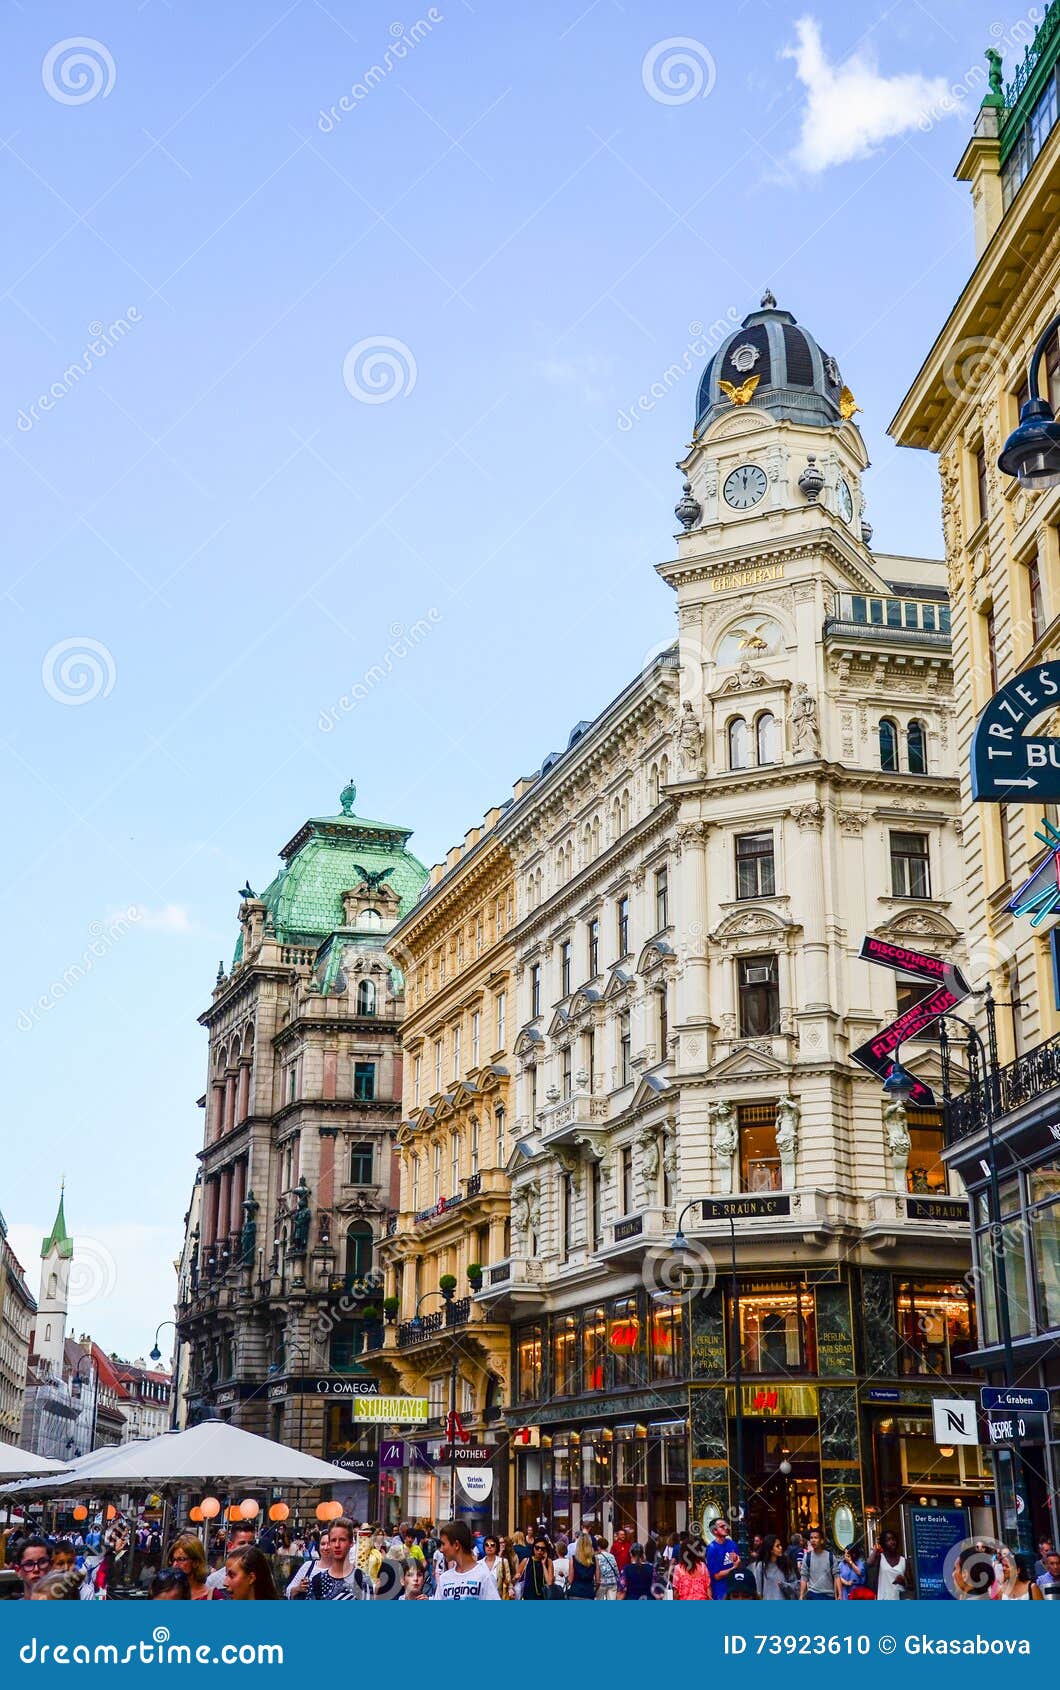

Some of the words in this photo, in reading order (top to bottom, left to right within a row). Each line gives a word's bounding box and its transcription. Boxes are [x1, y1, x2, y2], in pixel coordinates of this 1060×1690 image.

[711, 564, 785, 592] GENERALI
[869, 940, 951, 975] DISCOTHEQUE
[893, 1004, 922, 1029] CABARET
[724, 1202, 757, 1215] BRAUN
[929, 1205, 963, 1217] BRAUN
[697, 1335, 718, 1345] BERLIN
[823, 1332, 846, 1341] BERLIN
[333, 1383, 378, 1393] OMEGA
[1006, 1395, 1034, 1405] Graben
[359, 1398, 424, 1417] STURMAYR
[986, 1419, 1026, 1443] NESPREO
[340, 1460, 365, 1468] OMEGA
[443, 1581, 481, 1600] original
